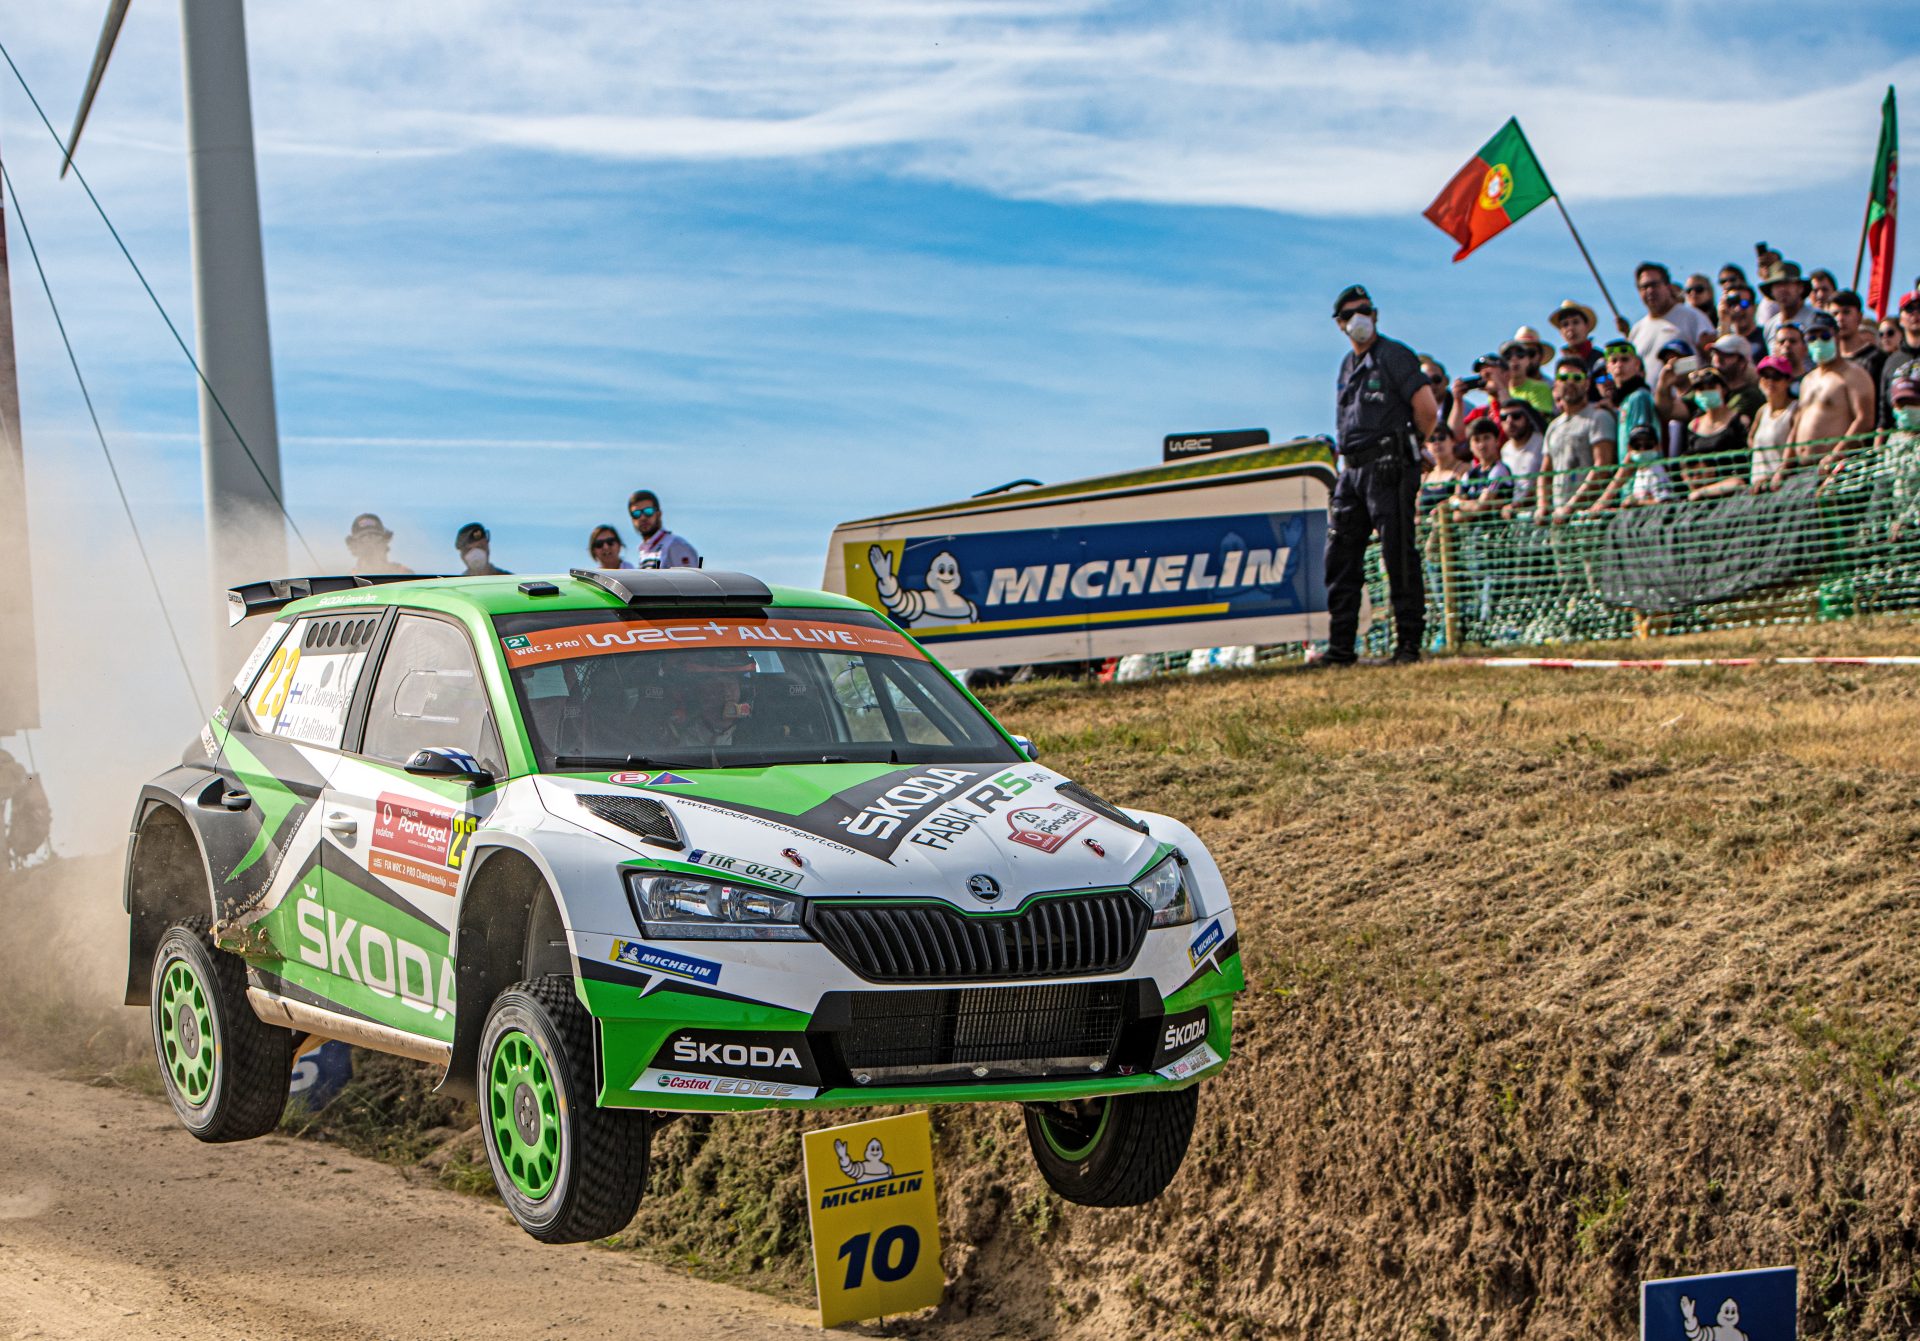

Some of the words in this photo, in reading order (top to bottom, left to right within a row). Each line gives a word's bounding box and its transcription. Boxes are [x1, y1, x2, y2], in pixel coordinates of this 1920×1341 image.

[1169, 438, 1212, 452] WRC
[985, 546, 1290, 607] MICHELIN
[514, 645, 542, 656] WRC
[546, 643, 553, 651] 2
[556, 639, 580, 650] PRO
[738, 626, 792, 641] ALL
[793, 627, 858, 645] LIVE
[255, 647, 300, 718] 23
[620, 773, 639, 784] E
[838, 768, 979, 840] ŠKODA
[910, 801, 987, 850] FABIA
[966, 772, 1033, 814] R5
[1014, 811, 1041, 824] 23
[398, 816, 447, 843] Portugal
[676, 799, 856, 856] www.skoda-motorsport.com
[1041, 809, 1082, 835] Portugal
[402, 865, 407, 875] 2
[416, 868, 447, 888] Championship
[746, 862, 794, 885] 0427
[297, 883, 456, 1021] ŠKODA
[1197, 928, 1219, 957] MICHELIN
[641, 953, 712, 977] MICHELIN
[1164, 1018, 1206, 1050] ŠKODA
[673, 1036, 802, 1069] ŠKODA
[670, 1077, 712, 1091] Castrol
[714, 1079, 799, 1097] EDGE
[820, 1178, 922, 1209] MICHELIN
[837, 1224, 921, 1290] 10
